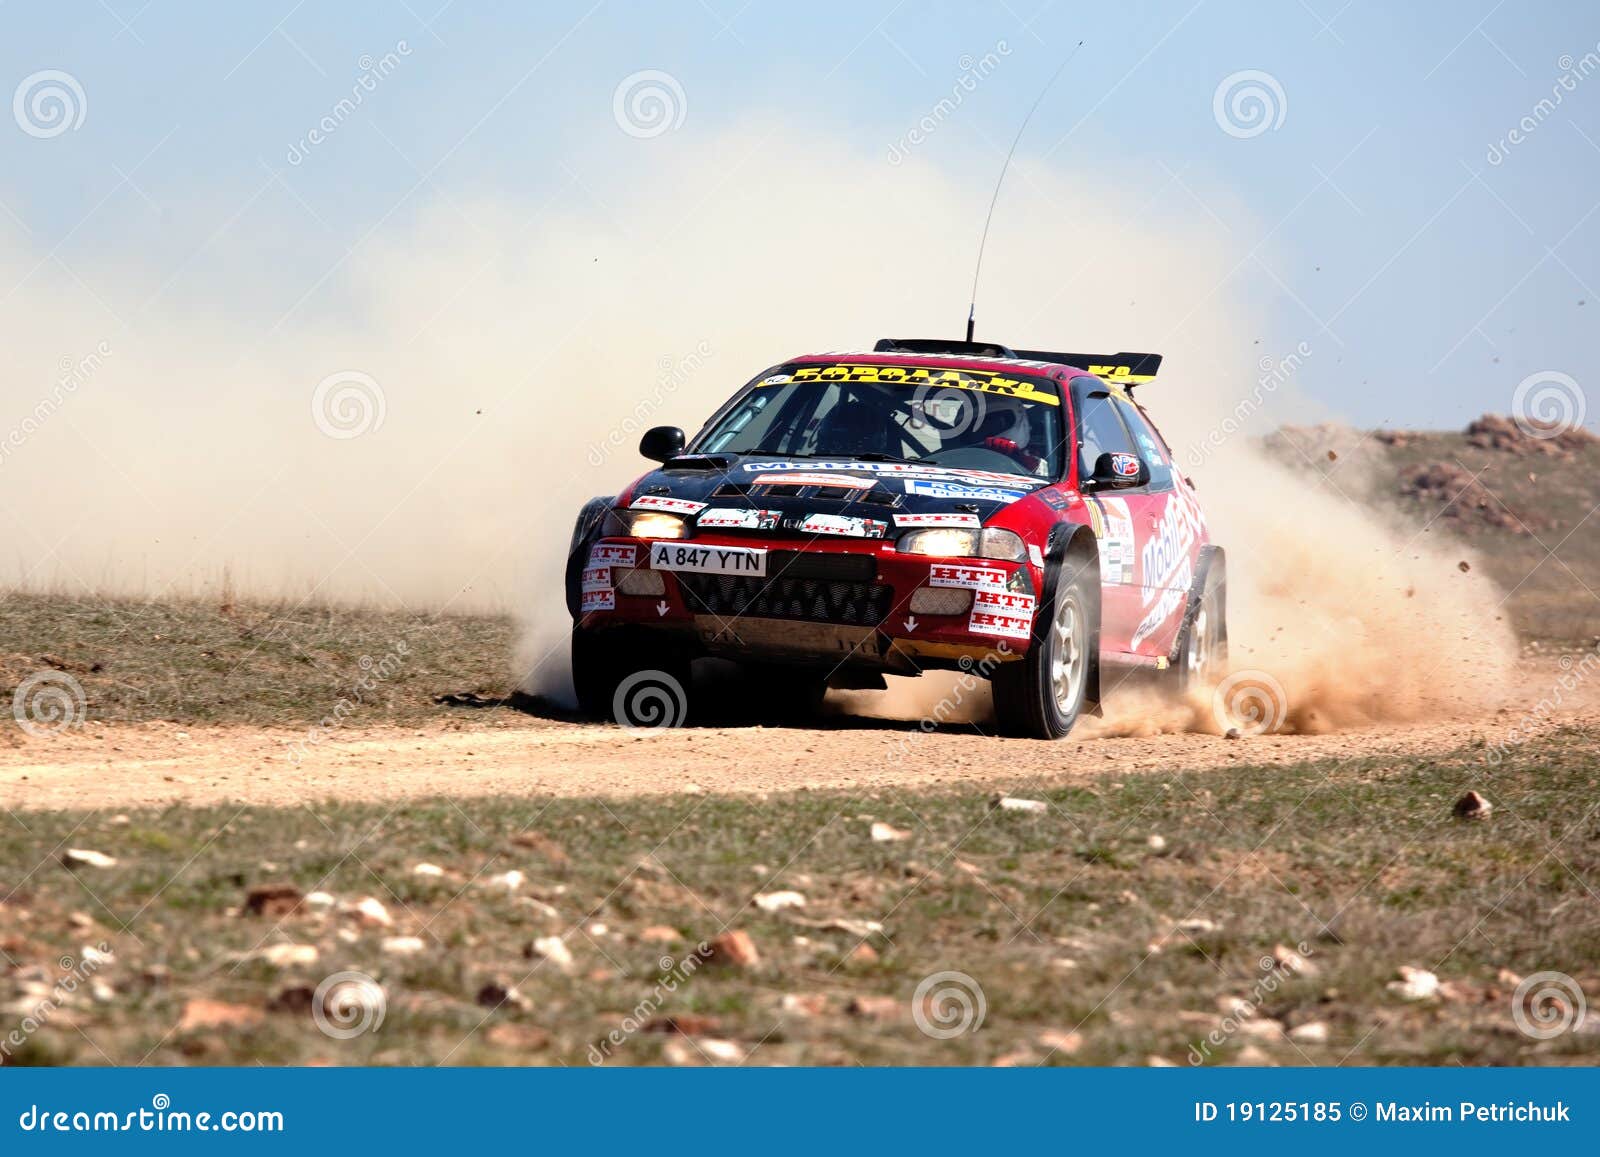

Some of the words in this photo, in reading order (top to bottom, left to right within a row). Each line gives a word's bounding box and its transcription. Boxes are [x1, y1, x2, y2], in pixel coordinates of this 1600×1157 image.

[636, 498, 703, 509] HTT
[896, 515, 976, 523] HTT
[656, 547, 670, 565] A
[675, 548, 711, 567] 847
[717, 550, 760, 570] YTN
[932, 567, 1005, 583] HTT
[976, 591, 1033, 609] HTT
[972, 612, 1030, 630] HTT
